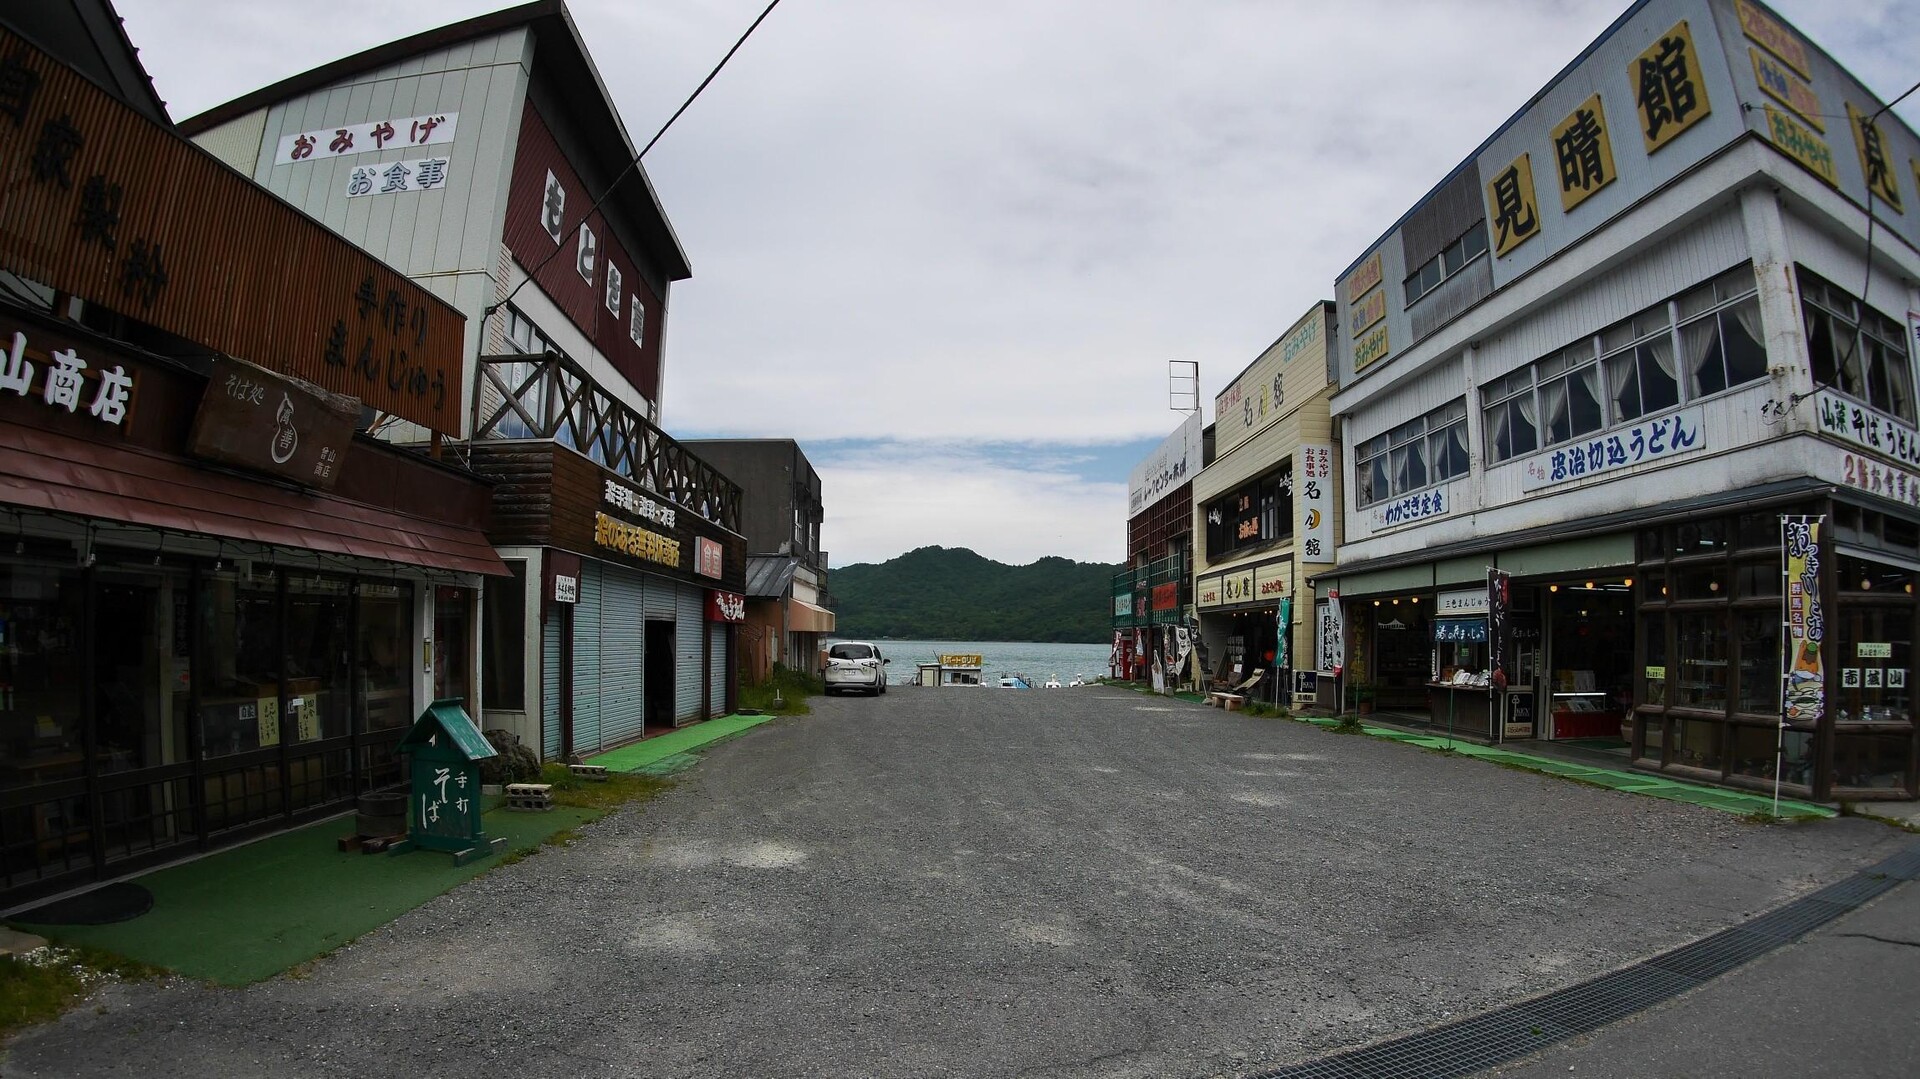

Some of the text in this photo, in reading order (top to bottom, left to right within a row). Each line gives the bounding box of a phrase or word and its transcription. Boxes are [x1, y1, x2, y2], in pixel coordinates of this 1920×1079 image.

[290, 115, 446, 161] おみやげ
[1493, 35, 1698, 252] 見晴館
[348, 158, 447, 196] お食事
[355, 275, 429, 347] 手作り
[0, 331, 133, 426] 山商店
[324, 318, 447, 411] まんじゅう
[225, 373, 265, 406] そば処
[1305, 447, 1316, 478] お食事処
[1318, 448, 1329, 478] おみやげ
[1550, 415, 1697, 482] 忠治切込うどん
[1385, 489, 1443, 526] わかさぎ定食
[1843, 669, 1905, 687] 赤城山
[421, 767, 451, 829] そば
[454, 771, 469, 815] 手打
